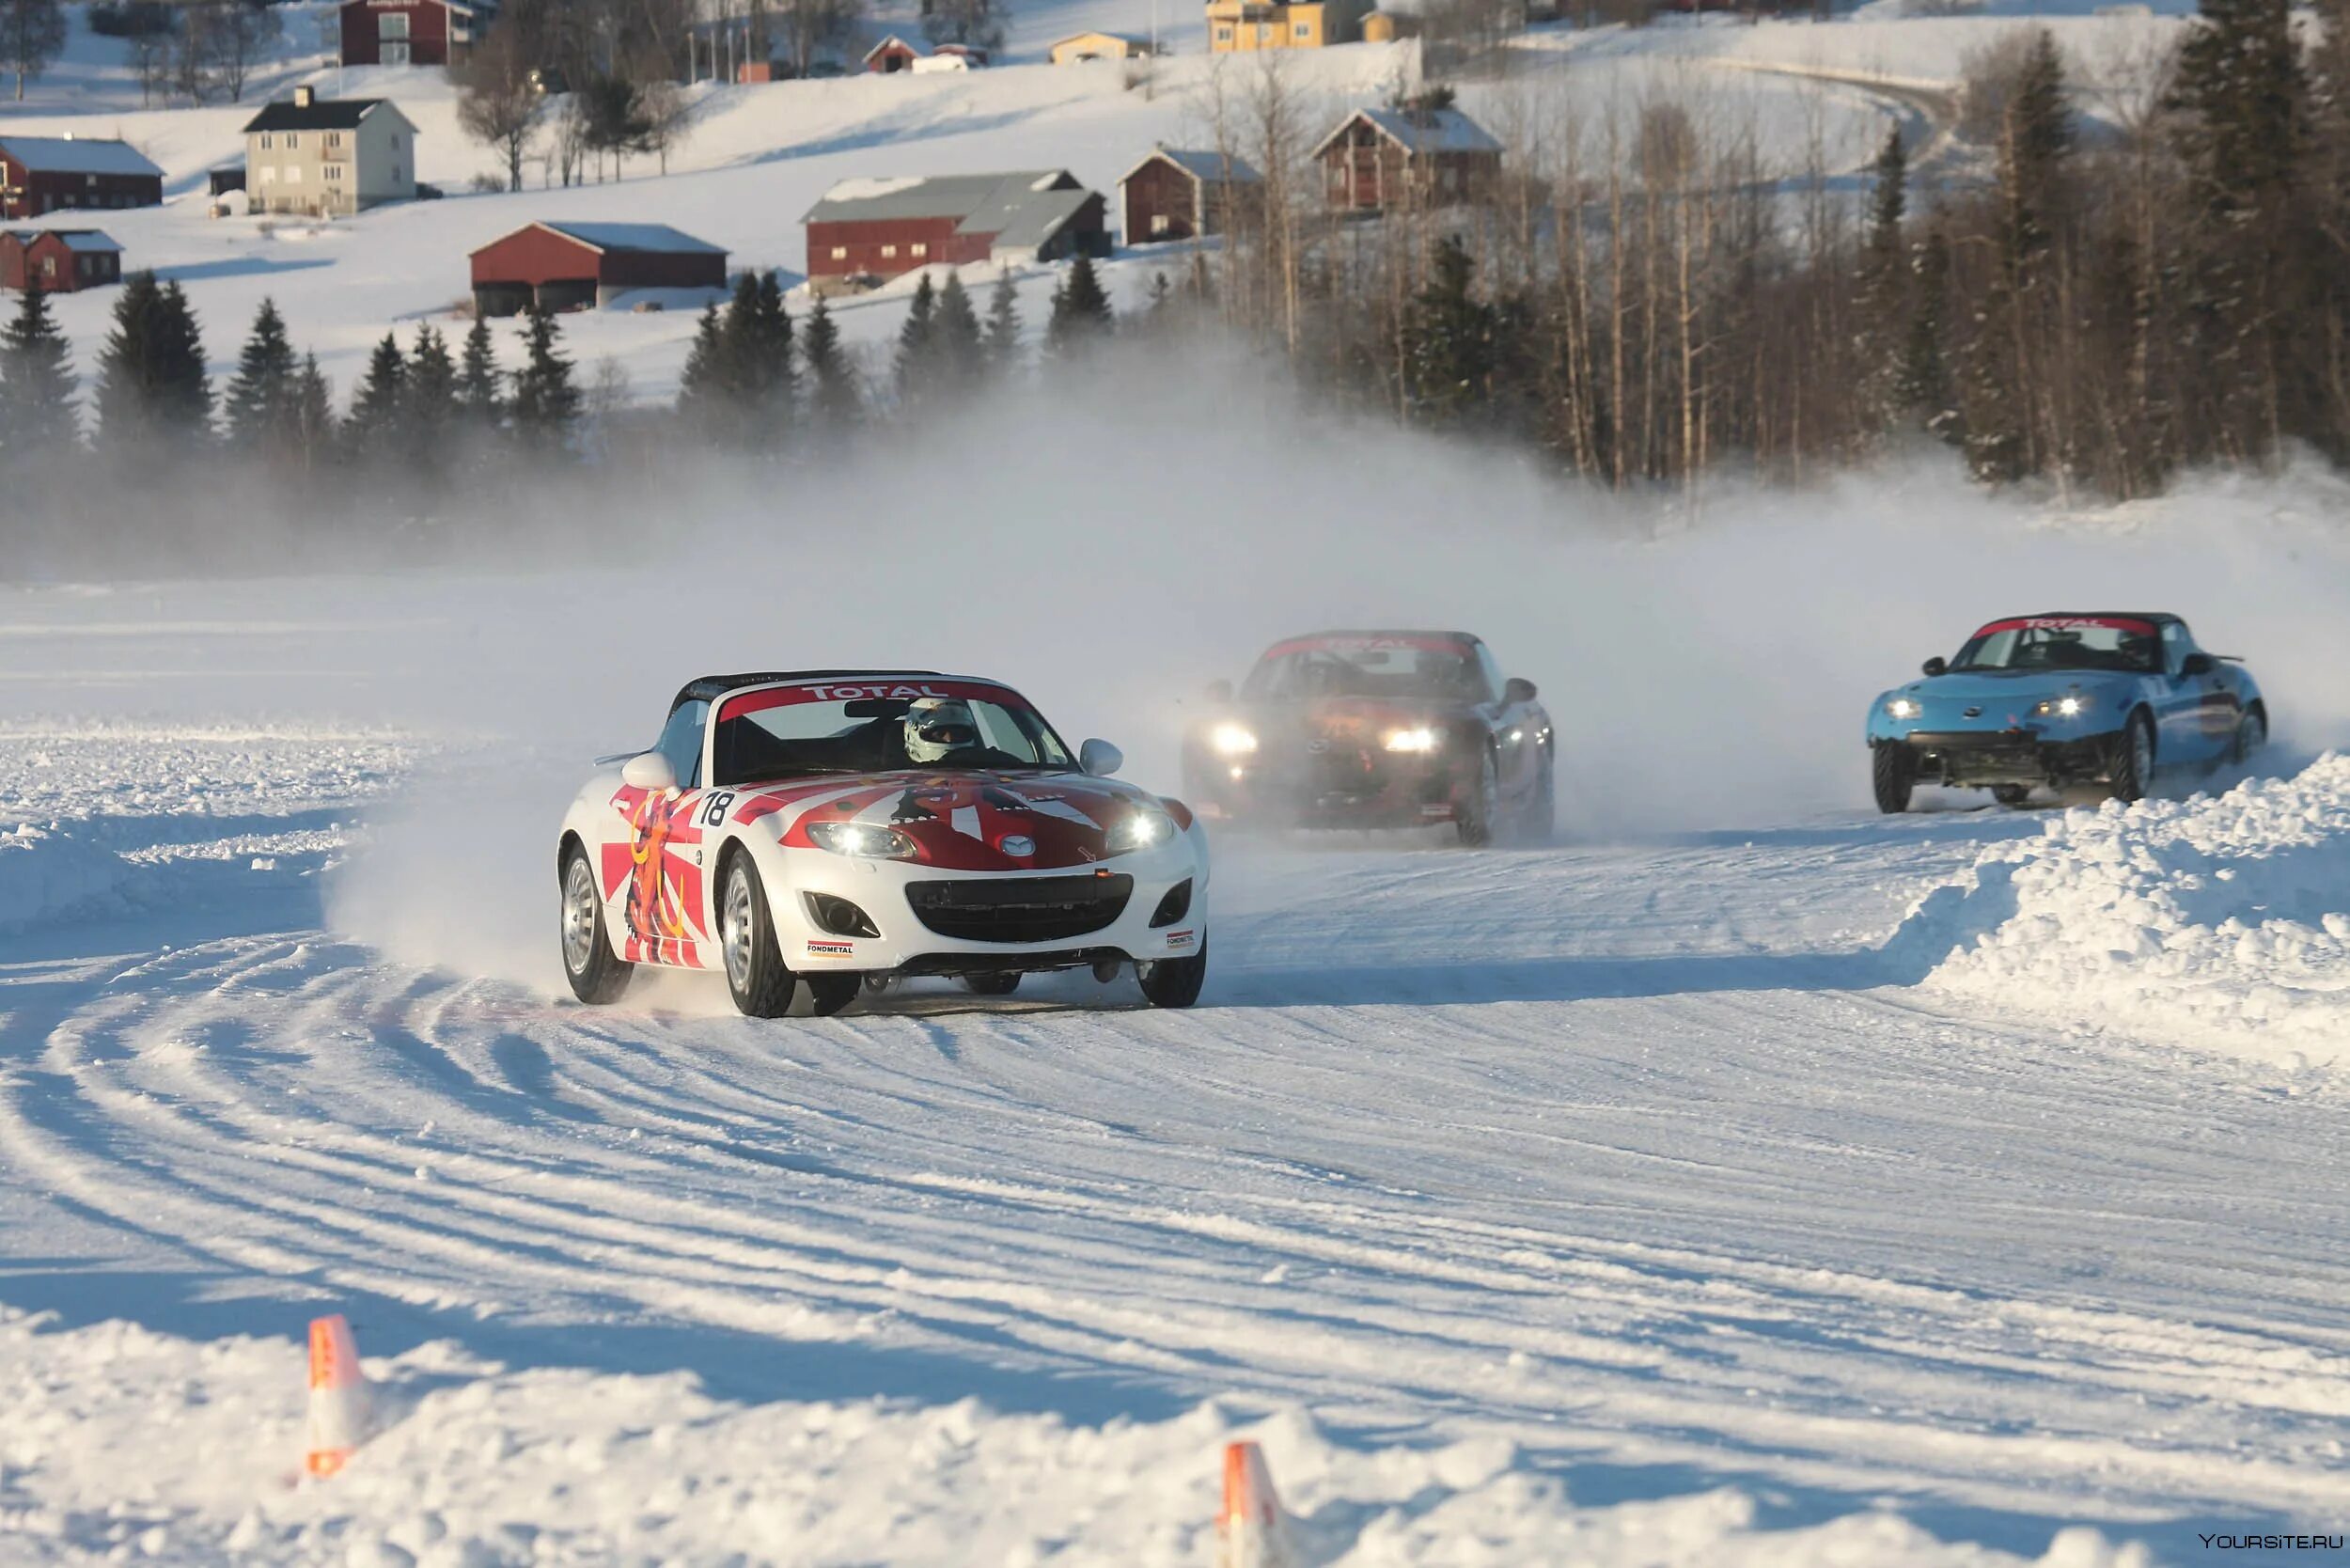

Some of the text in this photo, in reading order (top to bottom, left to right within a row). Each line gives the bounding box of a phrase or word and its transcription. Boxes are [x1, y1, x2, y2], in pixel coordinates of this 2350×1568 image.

[2024, 618, 2105, 628] TOTAL
[801, 685, 949, 700] TOTAL
[700, 791, 735, 827] 18
[807, 945, 854, 954] FONDMETAL
